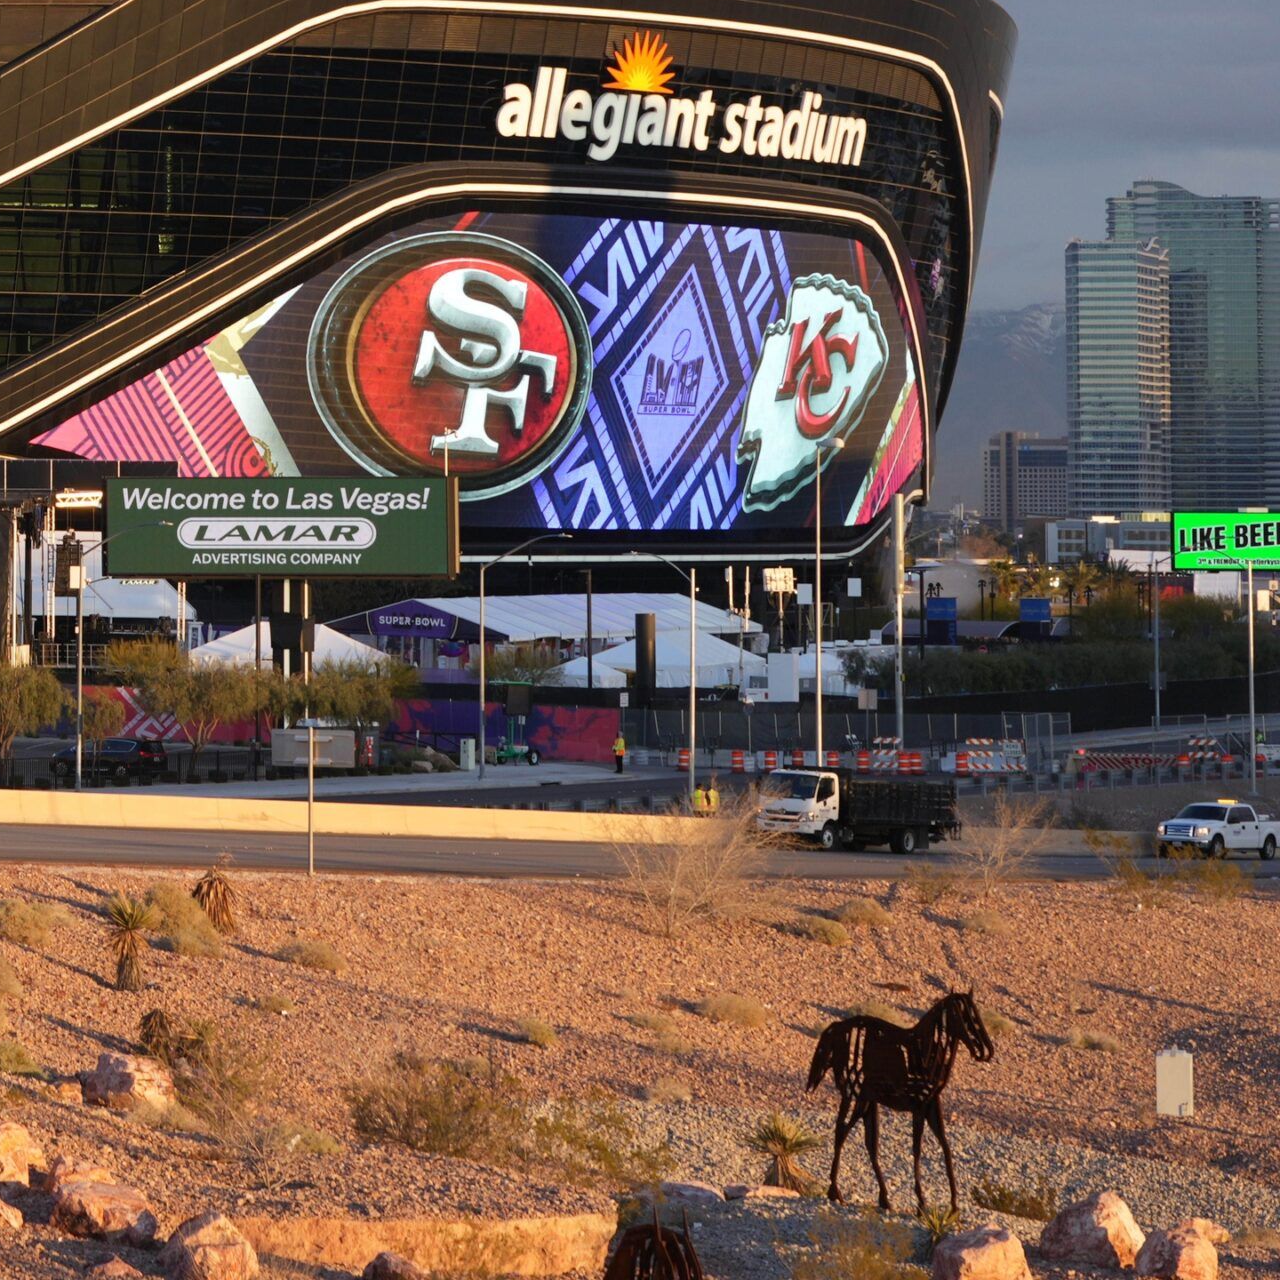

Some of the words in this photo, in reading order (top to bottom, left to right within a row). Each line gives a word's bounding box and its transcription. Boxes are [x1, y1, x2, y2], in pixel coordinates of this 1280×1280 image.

[496, 66, 716, 162] allegiant
[719, 91, 868, 167] stadium
[413, 268, 557, 455] SF
[775, 308, 860, 440] KC
[671, 406, 691, 414] BOWL
[122, 487, 245, 510] Welcome
[251, 489, 279, 510] to
[286, 487, 333, 510] Las
[340, 487, 430, 516] Vegas!
[193, 525, 360, 542] LAMAR
[1179, 526, 1226, 552] LIKE
[192, 553, 287, 565] ADVERTISING
[290, 553, 362, 565] COMPANY
[378, 615, 411, 626] SUPER
[415, 617, 446, 628] BOWL
[1121, 756, 1162, 768] STOP
